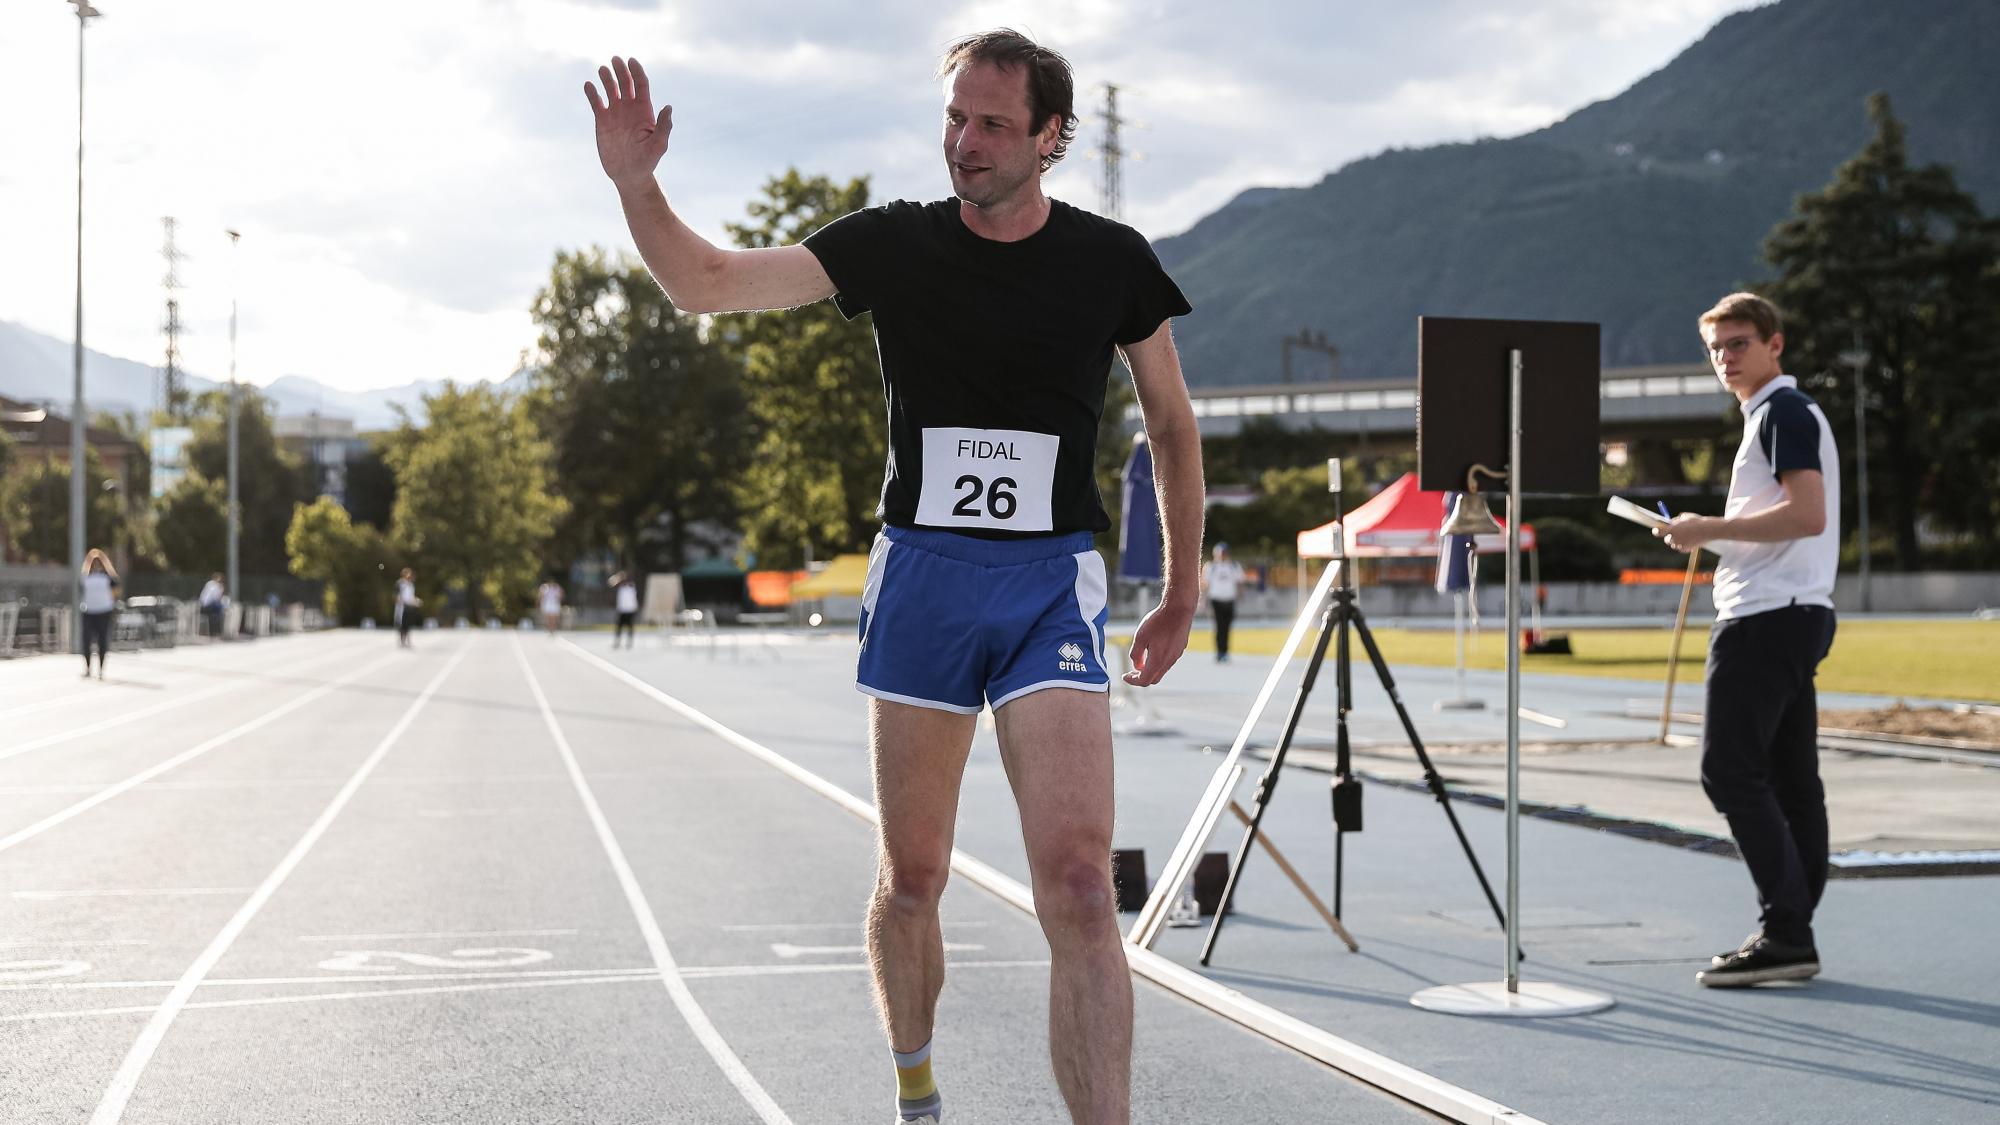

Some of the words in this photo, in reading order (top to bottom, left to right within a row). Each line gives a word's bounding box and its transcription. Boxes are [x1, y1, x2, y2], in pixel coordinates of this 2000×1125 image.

[957, 439, 1022, 461] FIDAL
[952, 474, 1018, 520] 26
[1059, 660, 1087, 673] errea
